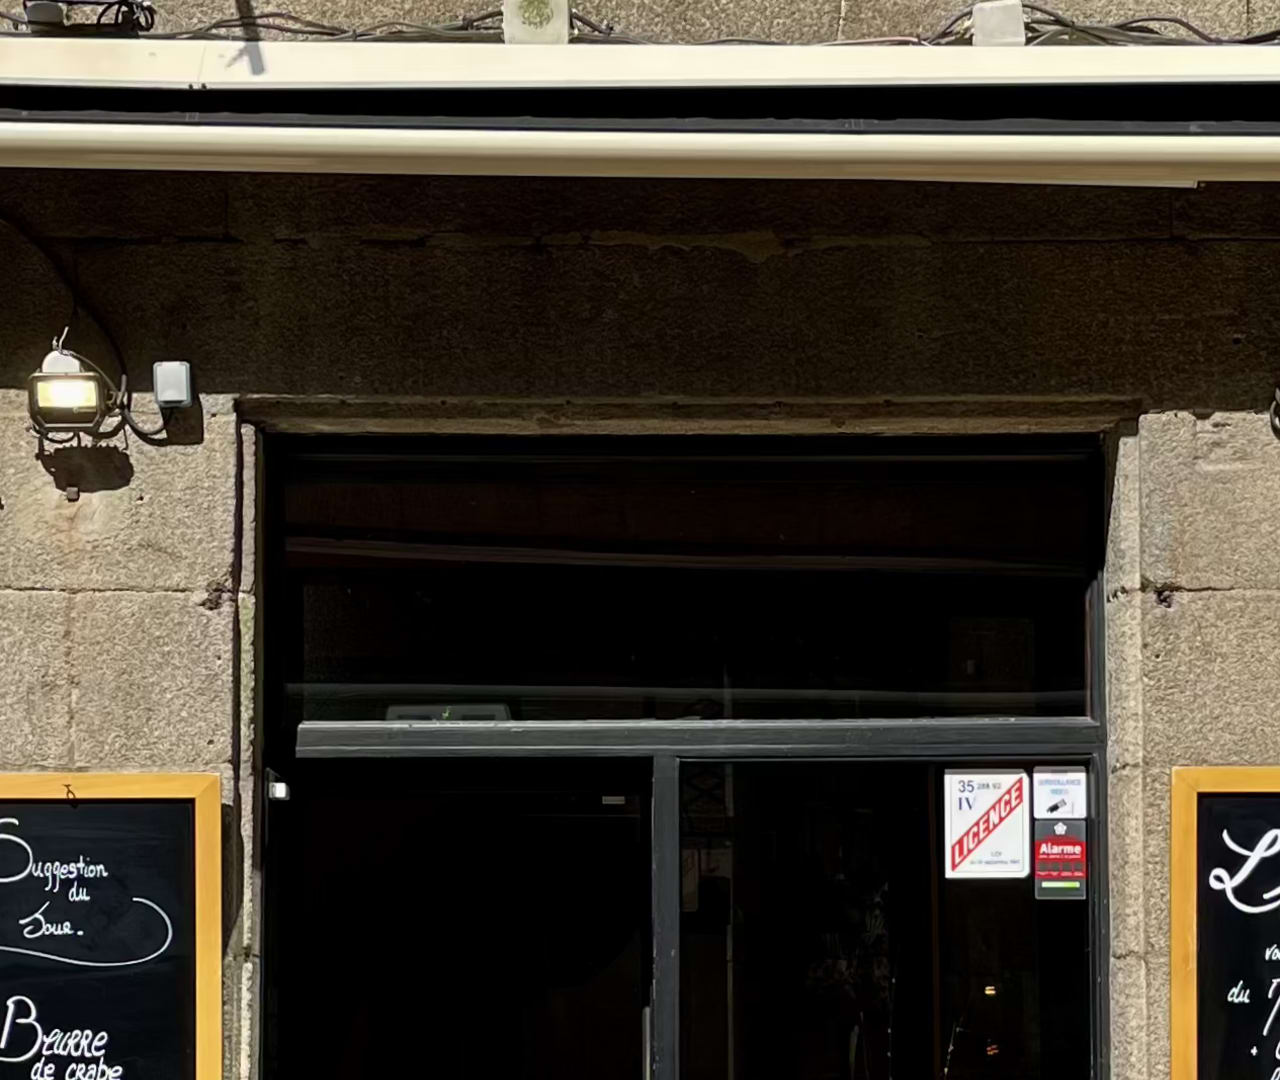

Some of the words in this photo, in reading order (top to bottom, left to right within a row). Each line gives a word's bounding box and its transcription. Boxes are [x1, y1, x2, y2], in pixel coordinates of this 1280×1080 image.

[958, 780, 974, 792] 35
[958, 797, 976, 810] IV
[954, 785, 1021, 865] LICENCE
[1039, 843, 1082, 854] Alarme
[69, 881, 90, 901] du
[1227, 980, 1250, 1004] du
